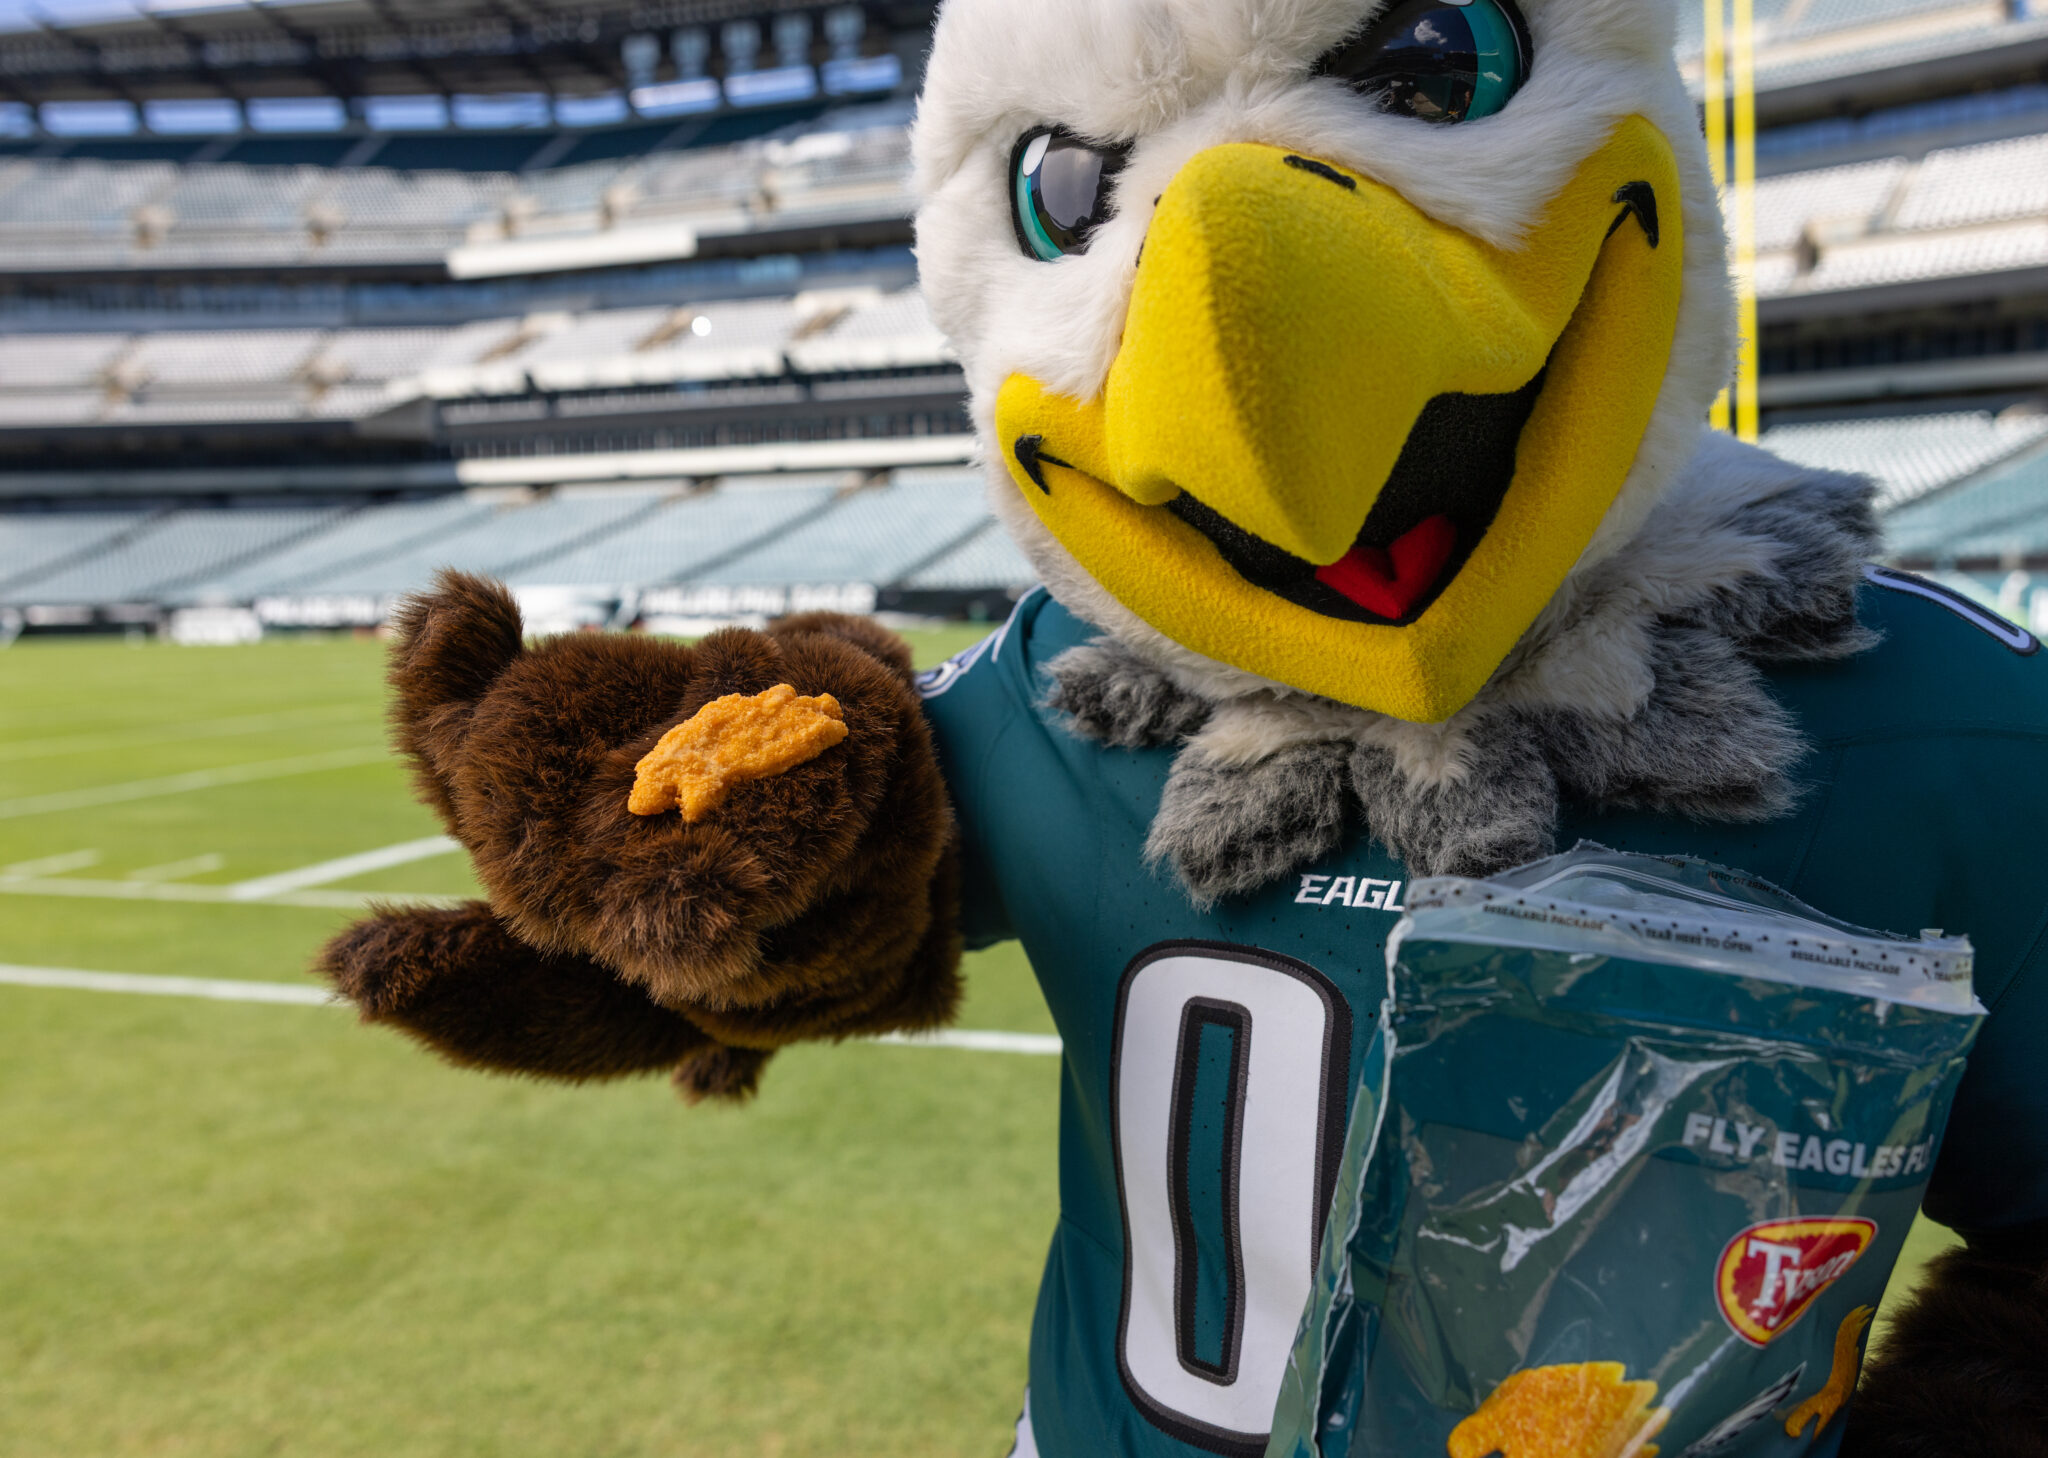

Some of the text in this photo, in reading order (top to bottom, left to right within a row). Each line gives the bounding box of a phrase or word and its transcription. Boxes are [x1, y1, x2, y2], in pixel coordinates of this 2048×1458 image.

[1294, 873, 1406, 912] EAGL
[1550, 913, 1605, 931] PACKAGE
[1645, 926, 1753, 953] TEAR HERE TO OPEN
[1790, 949, 1901, 976] RESEALABLE PACKAGE
[1681, 1111, 1931, 1179] FLY EAGLES FL
